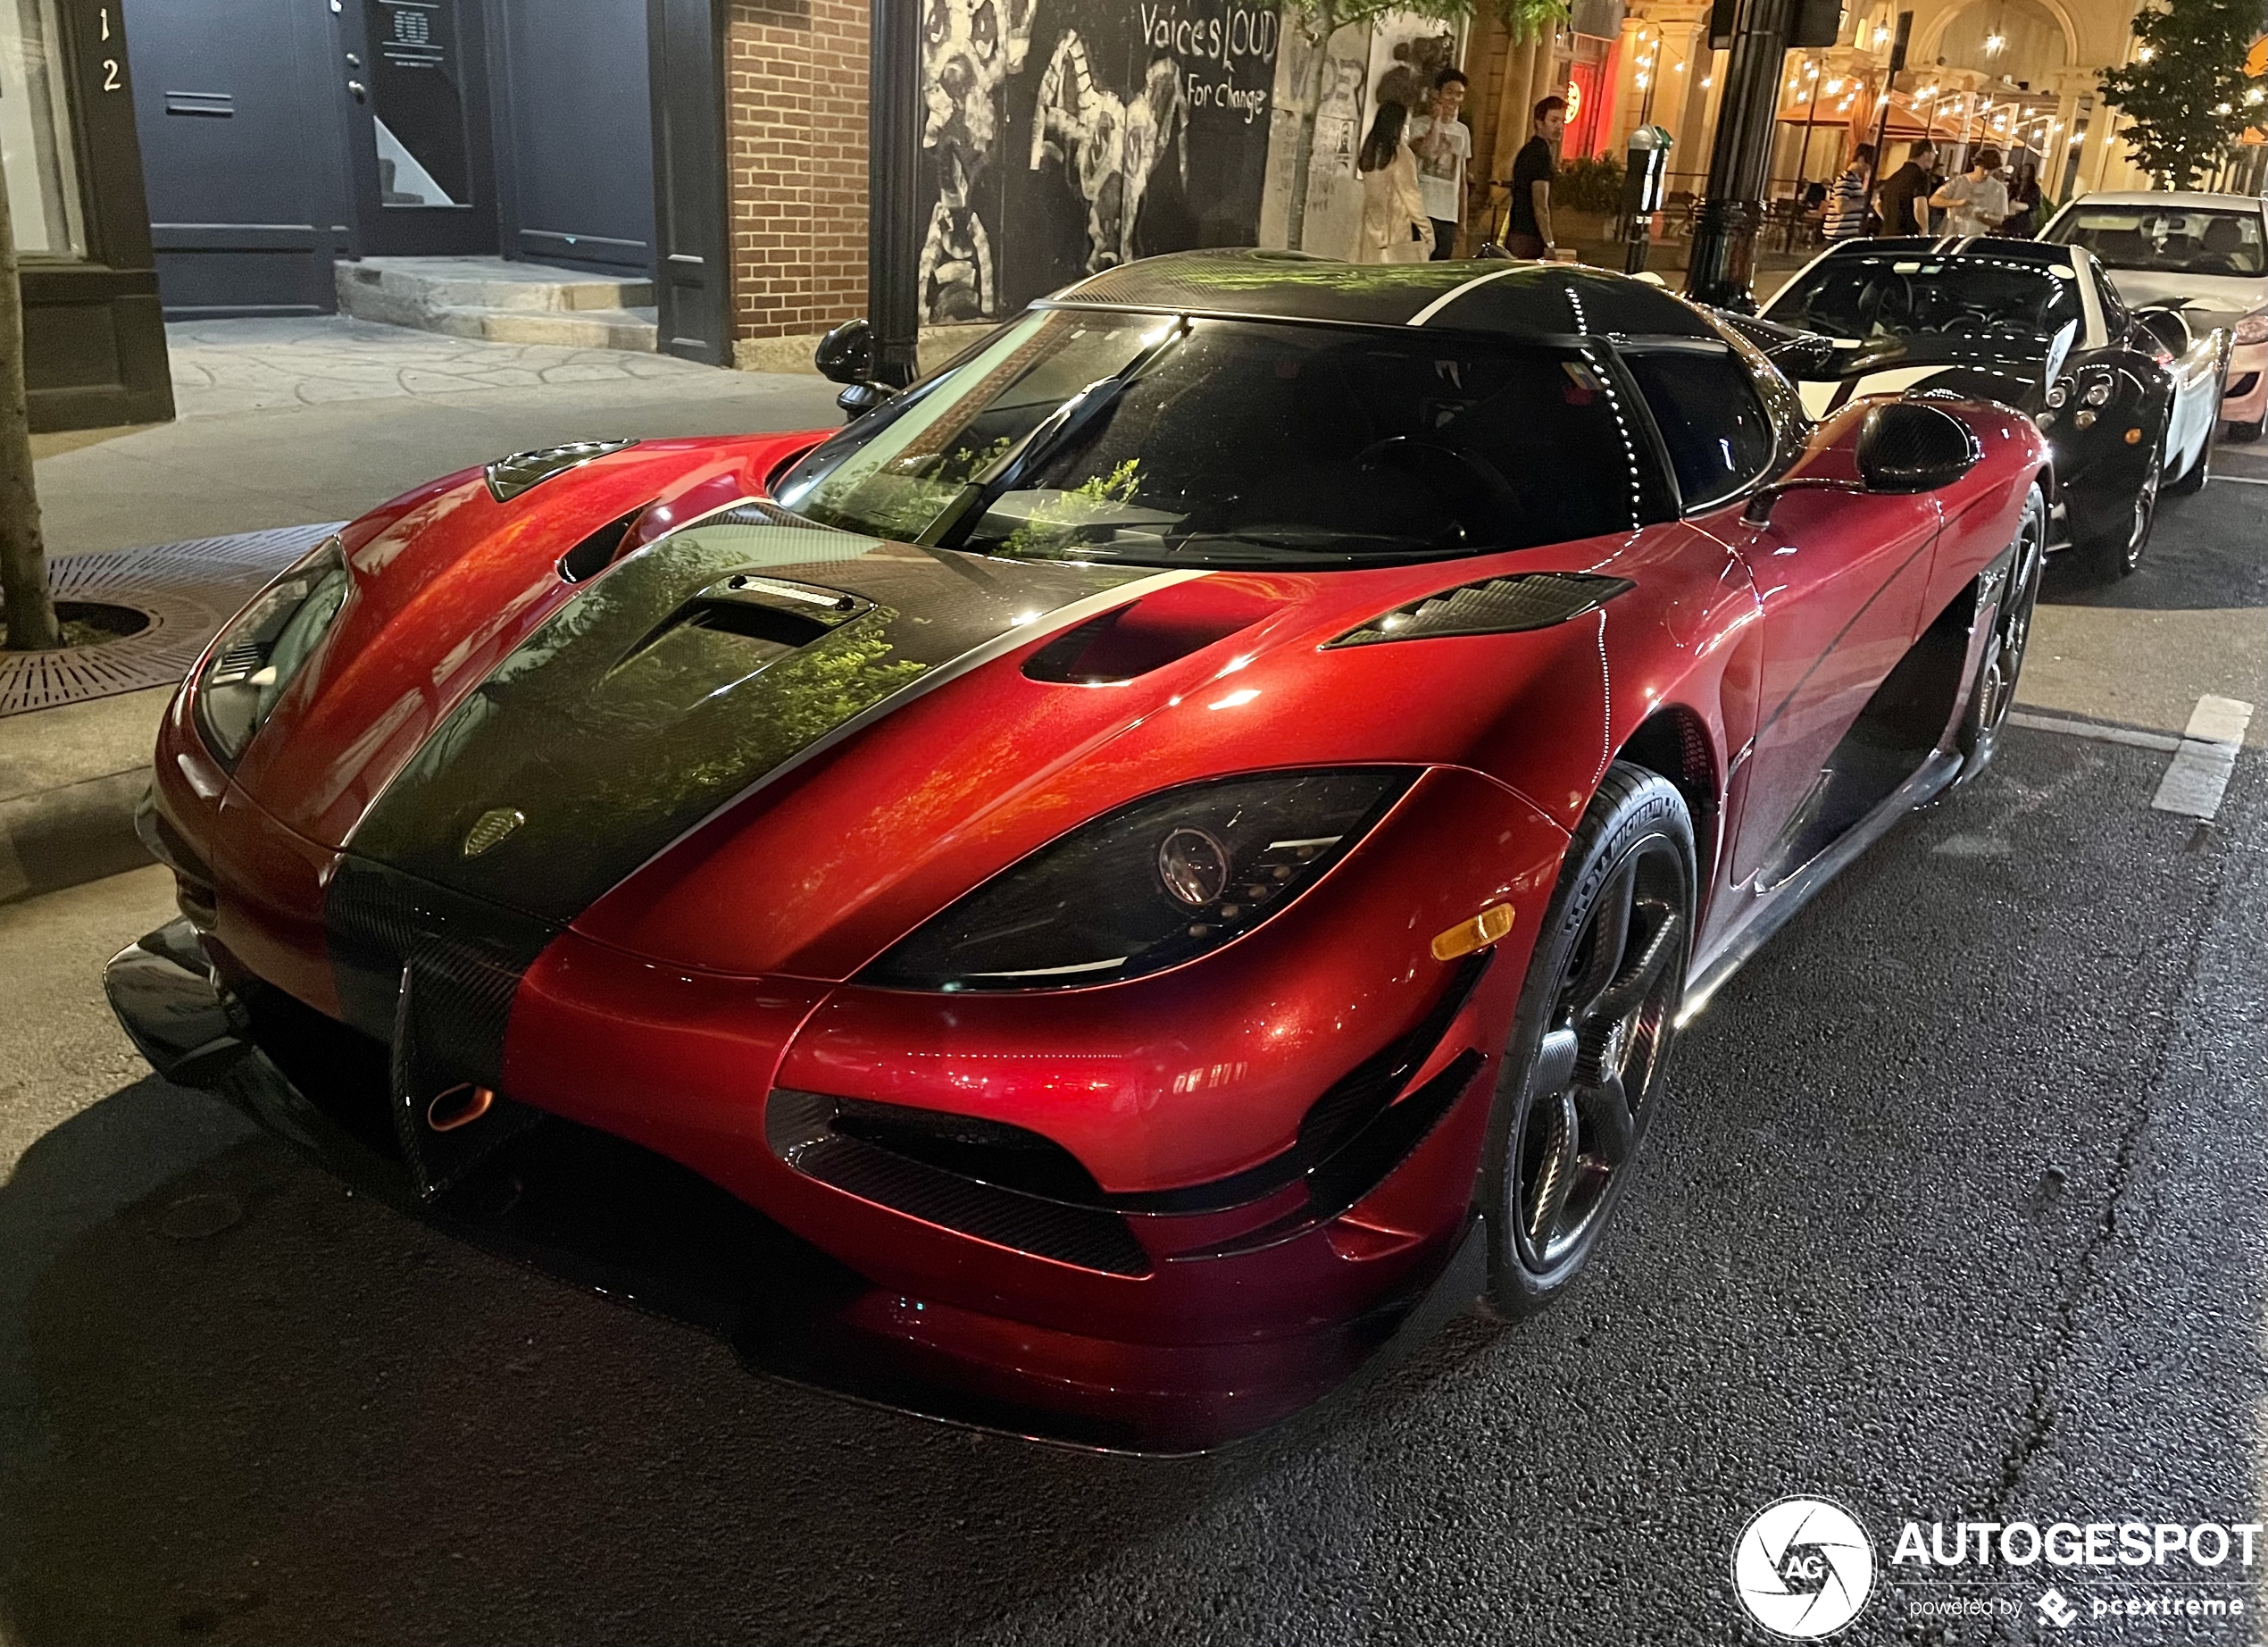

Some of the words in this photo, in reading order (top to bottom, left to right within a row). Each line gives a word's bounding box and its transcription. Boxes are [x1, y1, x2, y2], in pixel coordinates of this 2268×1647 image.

[1141, 3, 1221, 59] Voices
[1222, 5, 1278, 73] LOUD
[1188, 73, 1212, 108] For
[1610, 797, 1663, 858] MICHELIN
